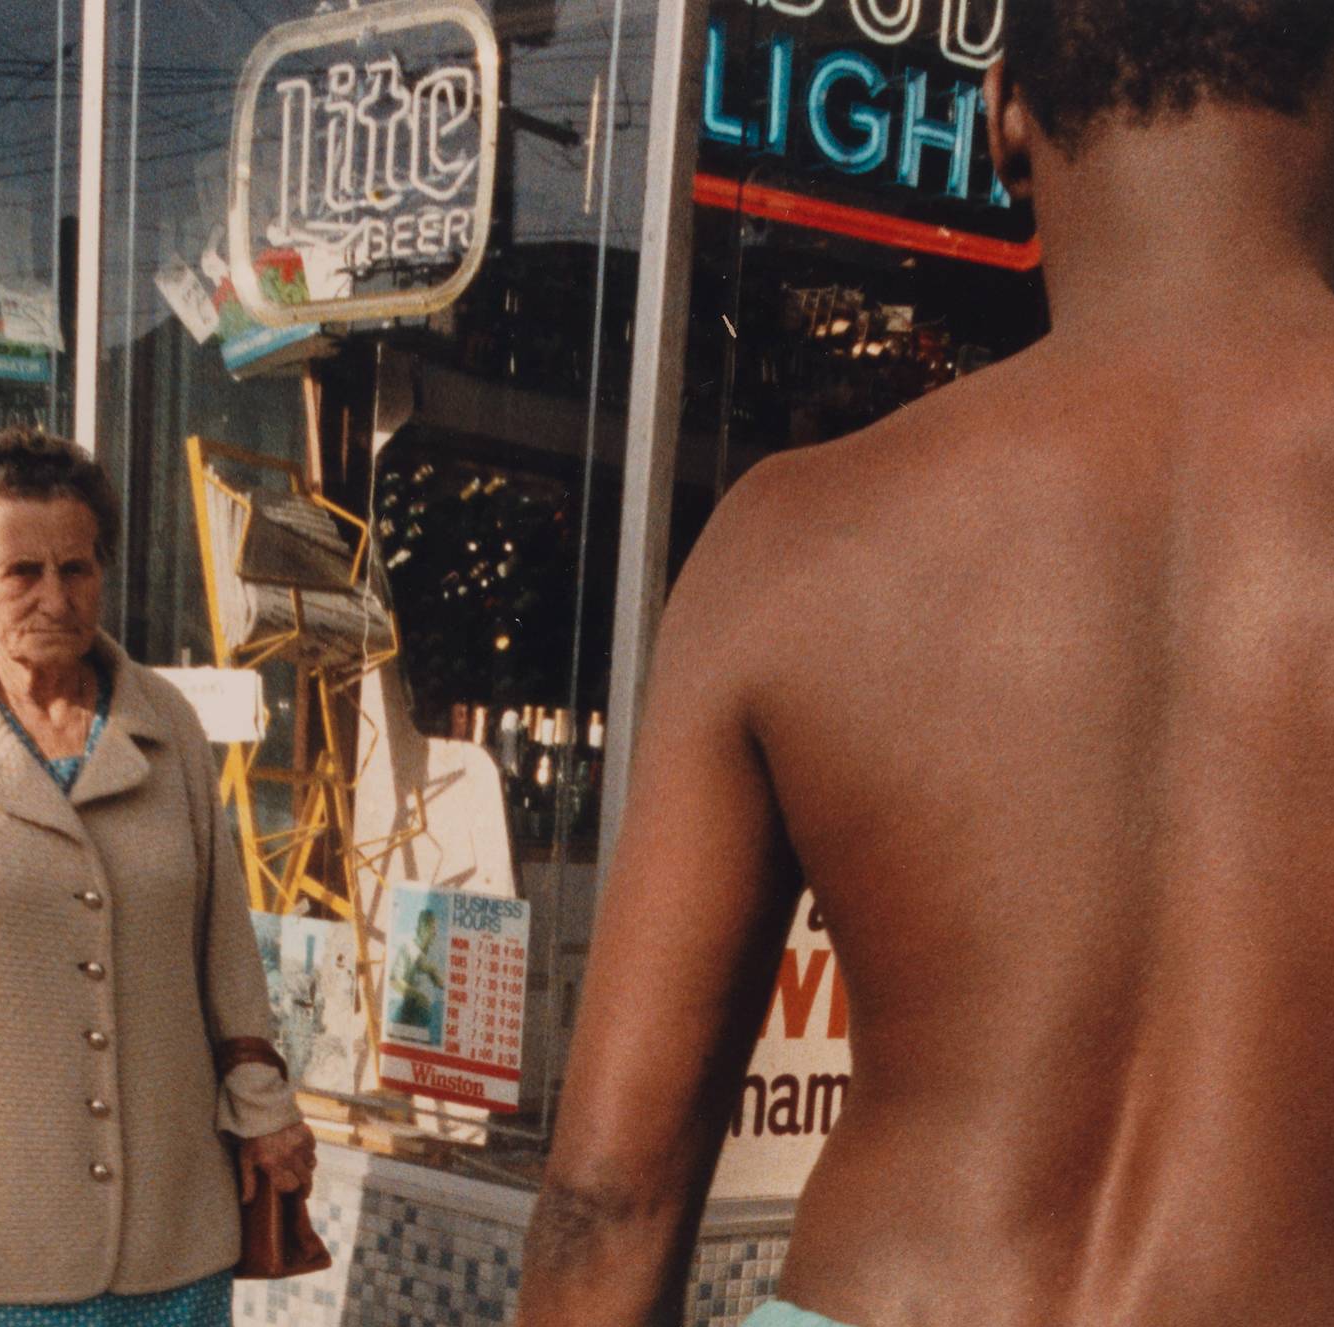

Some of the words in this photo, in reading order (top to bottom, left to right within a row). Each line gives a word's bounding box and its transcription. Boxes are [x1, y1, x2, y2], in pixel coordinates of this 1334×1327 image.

[703, 18, 1011, 208] LIGH
[365, 207, 473, 261] BEER
[453, 909, 501, 933] HOURS
[454, 893, 523, 918] BUSINESS
[410, 1060, 485, 1097] Winston
